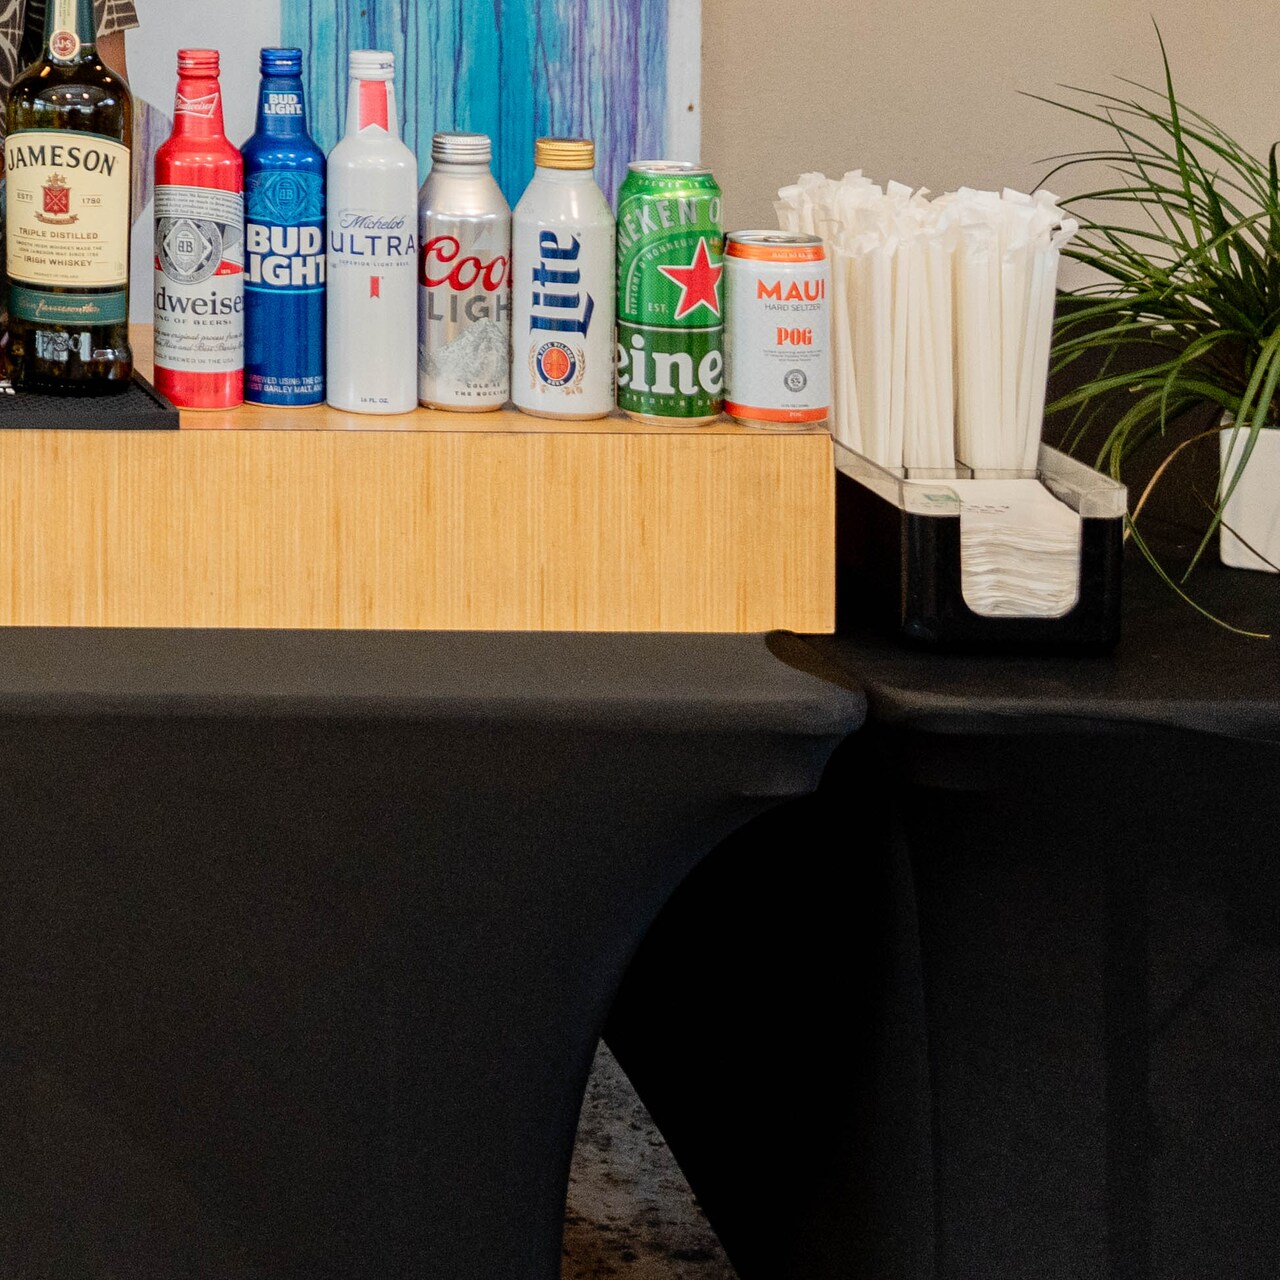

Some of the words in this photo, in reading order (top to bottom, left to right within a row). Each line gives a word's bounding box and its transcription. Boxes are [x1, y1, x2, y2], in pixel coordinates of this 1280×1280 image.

[264, 104, 302, 114] LIGHT
[269, 93, 298, 104] BUD
[8, 145, 116, 177] JAMESON
[19, 227, 47, 238] TRIPLE
[50, 231, 98, 240] DISTILLED
[340, 213, 407, 230] Michelob
[618, 197, 697, 256] NEKEN
[247, 223, 322, 256] BUD
[331, 230, 416, 256] ULTRA
[24, 255, 46, 264] IRISH
[48, 258, 93, 267] WHISKEY
[418, 235, 513, 291] Coo
[529, 230, 595, 340] Lite
[756, 279, 825, 301] MAUI
[154, 287, 243, 316] dweise
[428, 291, 512, 323] LIGH
[764, 303, 789, 311] HARD
[791, 303, 820, 311] SELTZER
[777, 326, 813, 345] POG
[617, 333, 723, 395] eine
[263, 384, 293, 393] BARLEY
